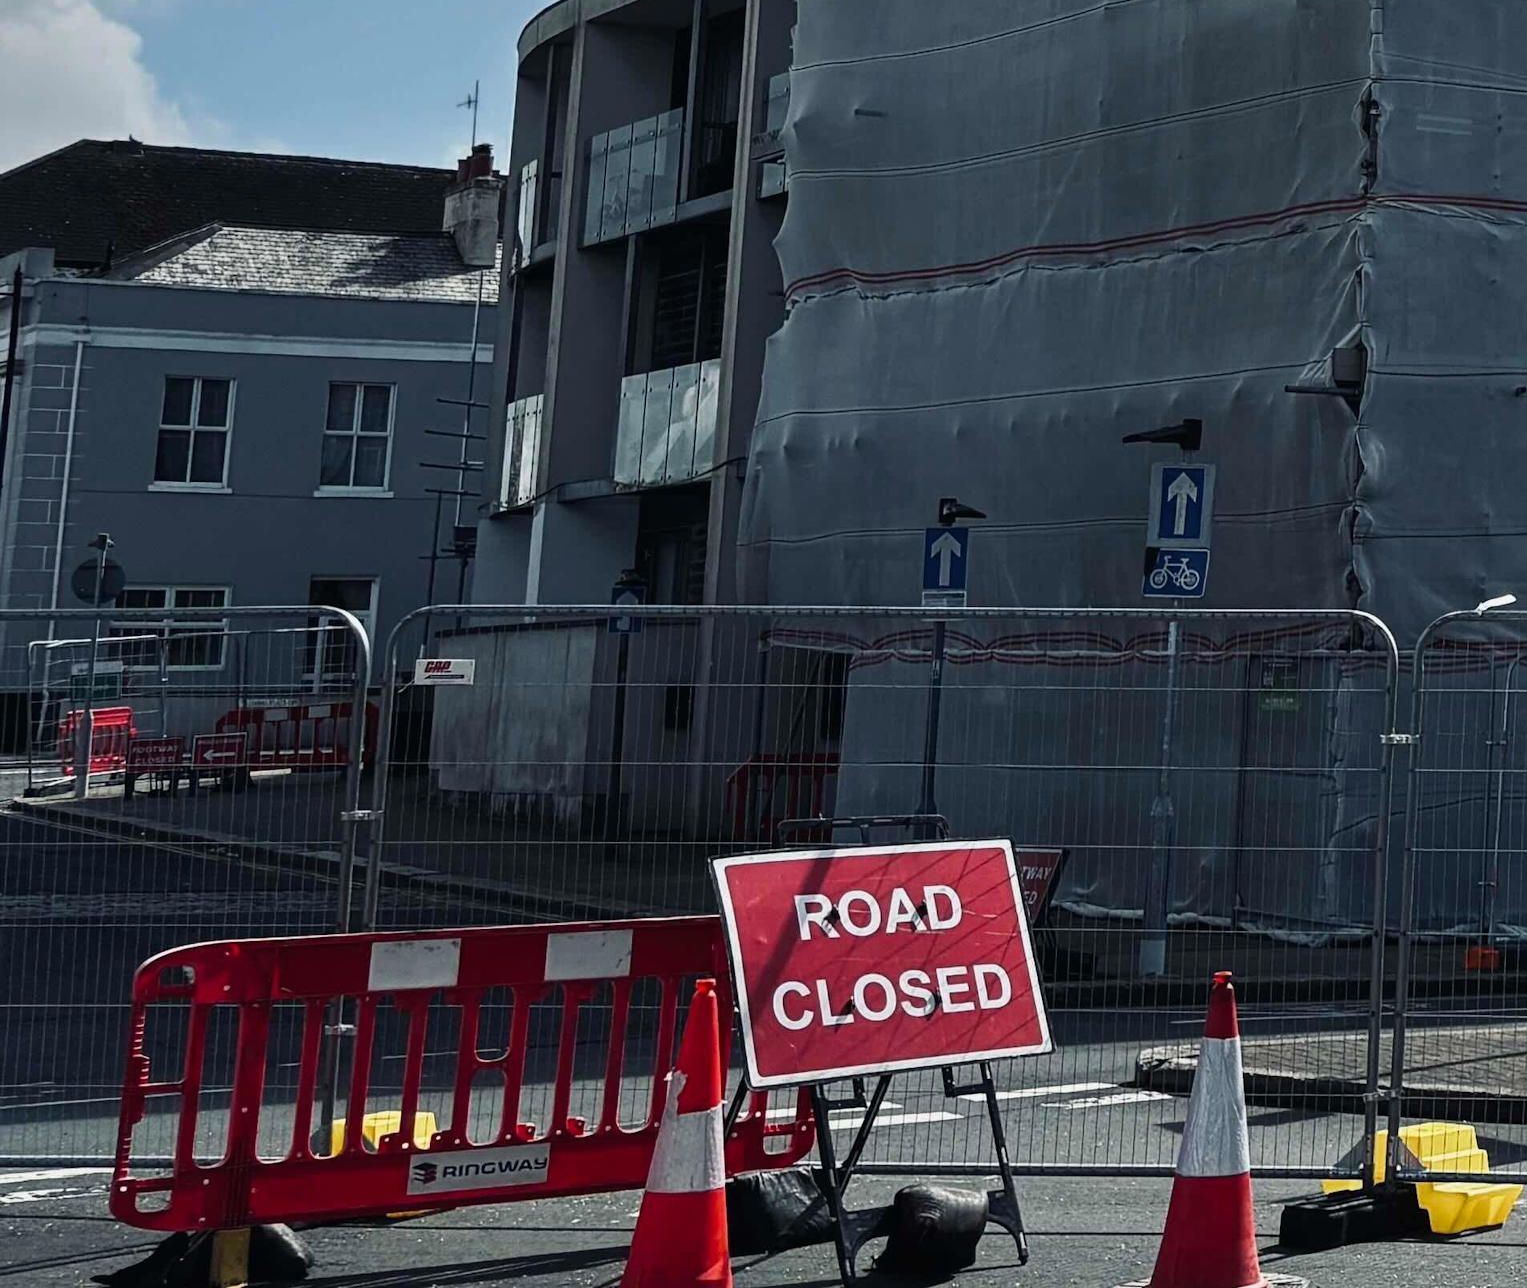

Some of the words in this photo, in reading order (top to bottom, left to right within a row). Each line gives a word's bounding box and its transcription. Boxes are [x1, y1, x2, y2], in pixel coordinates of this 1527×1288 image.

[132, 744, 179, 754] FOOTWAY
[135, 755, 176, 765] CLOSED
[793, 884, 963, 941] ROAD
[772, 963, 1012, 1031] CLOSED
[442, 1157, 548, 1178] RINGWAY
